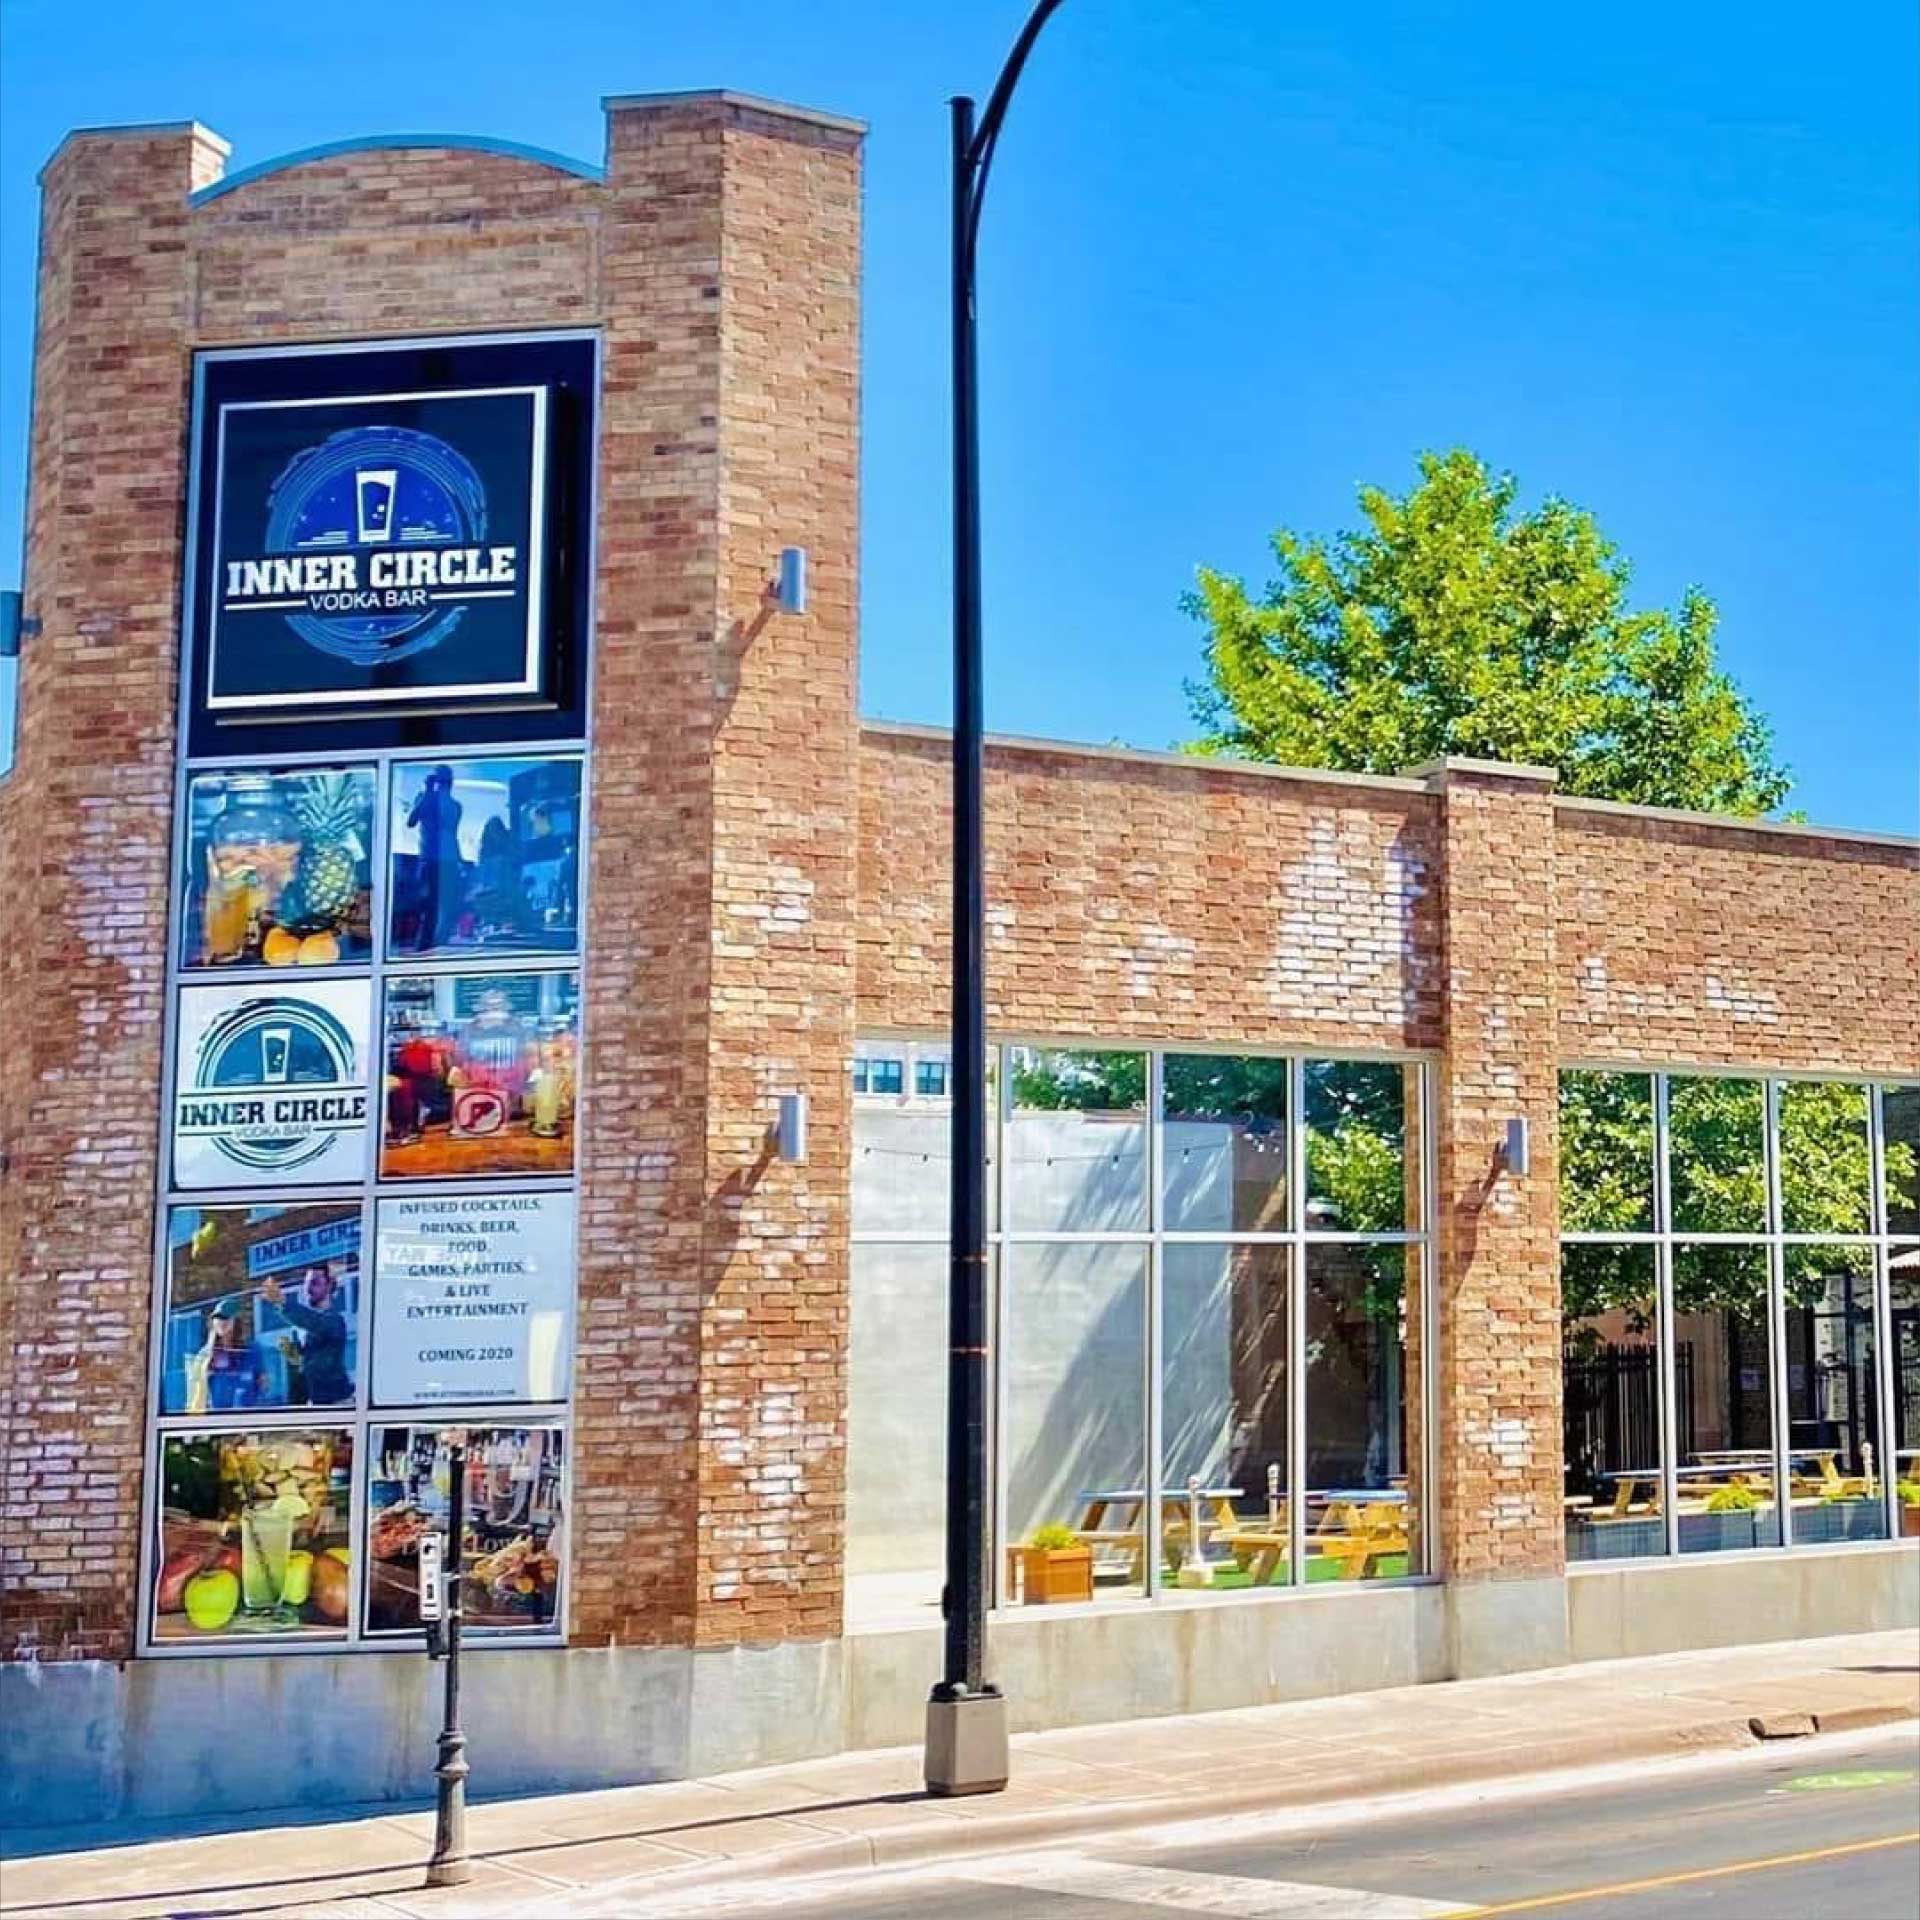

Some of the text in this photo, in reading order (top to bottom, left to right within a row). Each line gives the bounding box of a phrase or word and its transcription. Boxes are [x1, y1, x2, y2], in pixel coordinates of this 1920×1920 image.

[226, 546, 516, 596] INNER CIRCLE
[310, 589, 428, 611] VODKA BAR
[180, 1097, 367, 1126] INNER CIRCLE
[400, 1202, 457, 1214] INFUSED
[460, 1284, 491, 1297] LIVE
[406, 1303, 528, 1318] ENTERTAINMENT
[418, 1348, 513, 1362] COMING 2020
